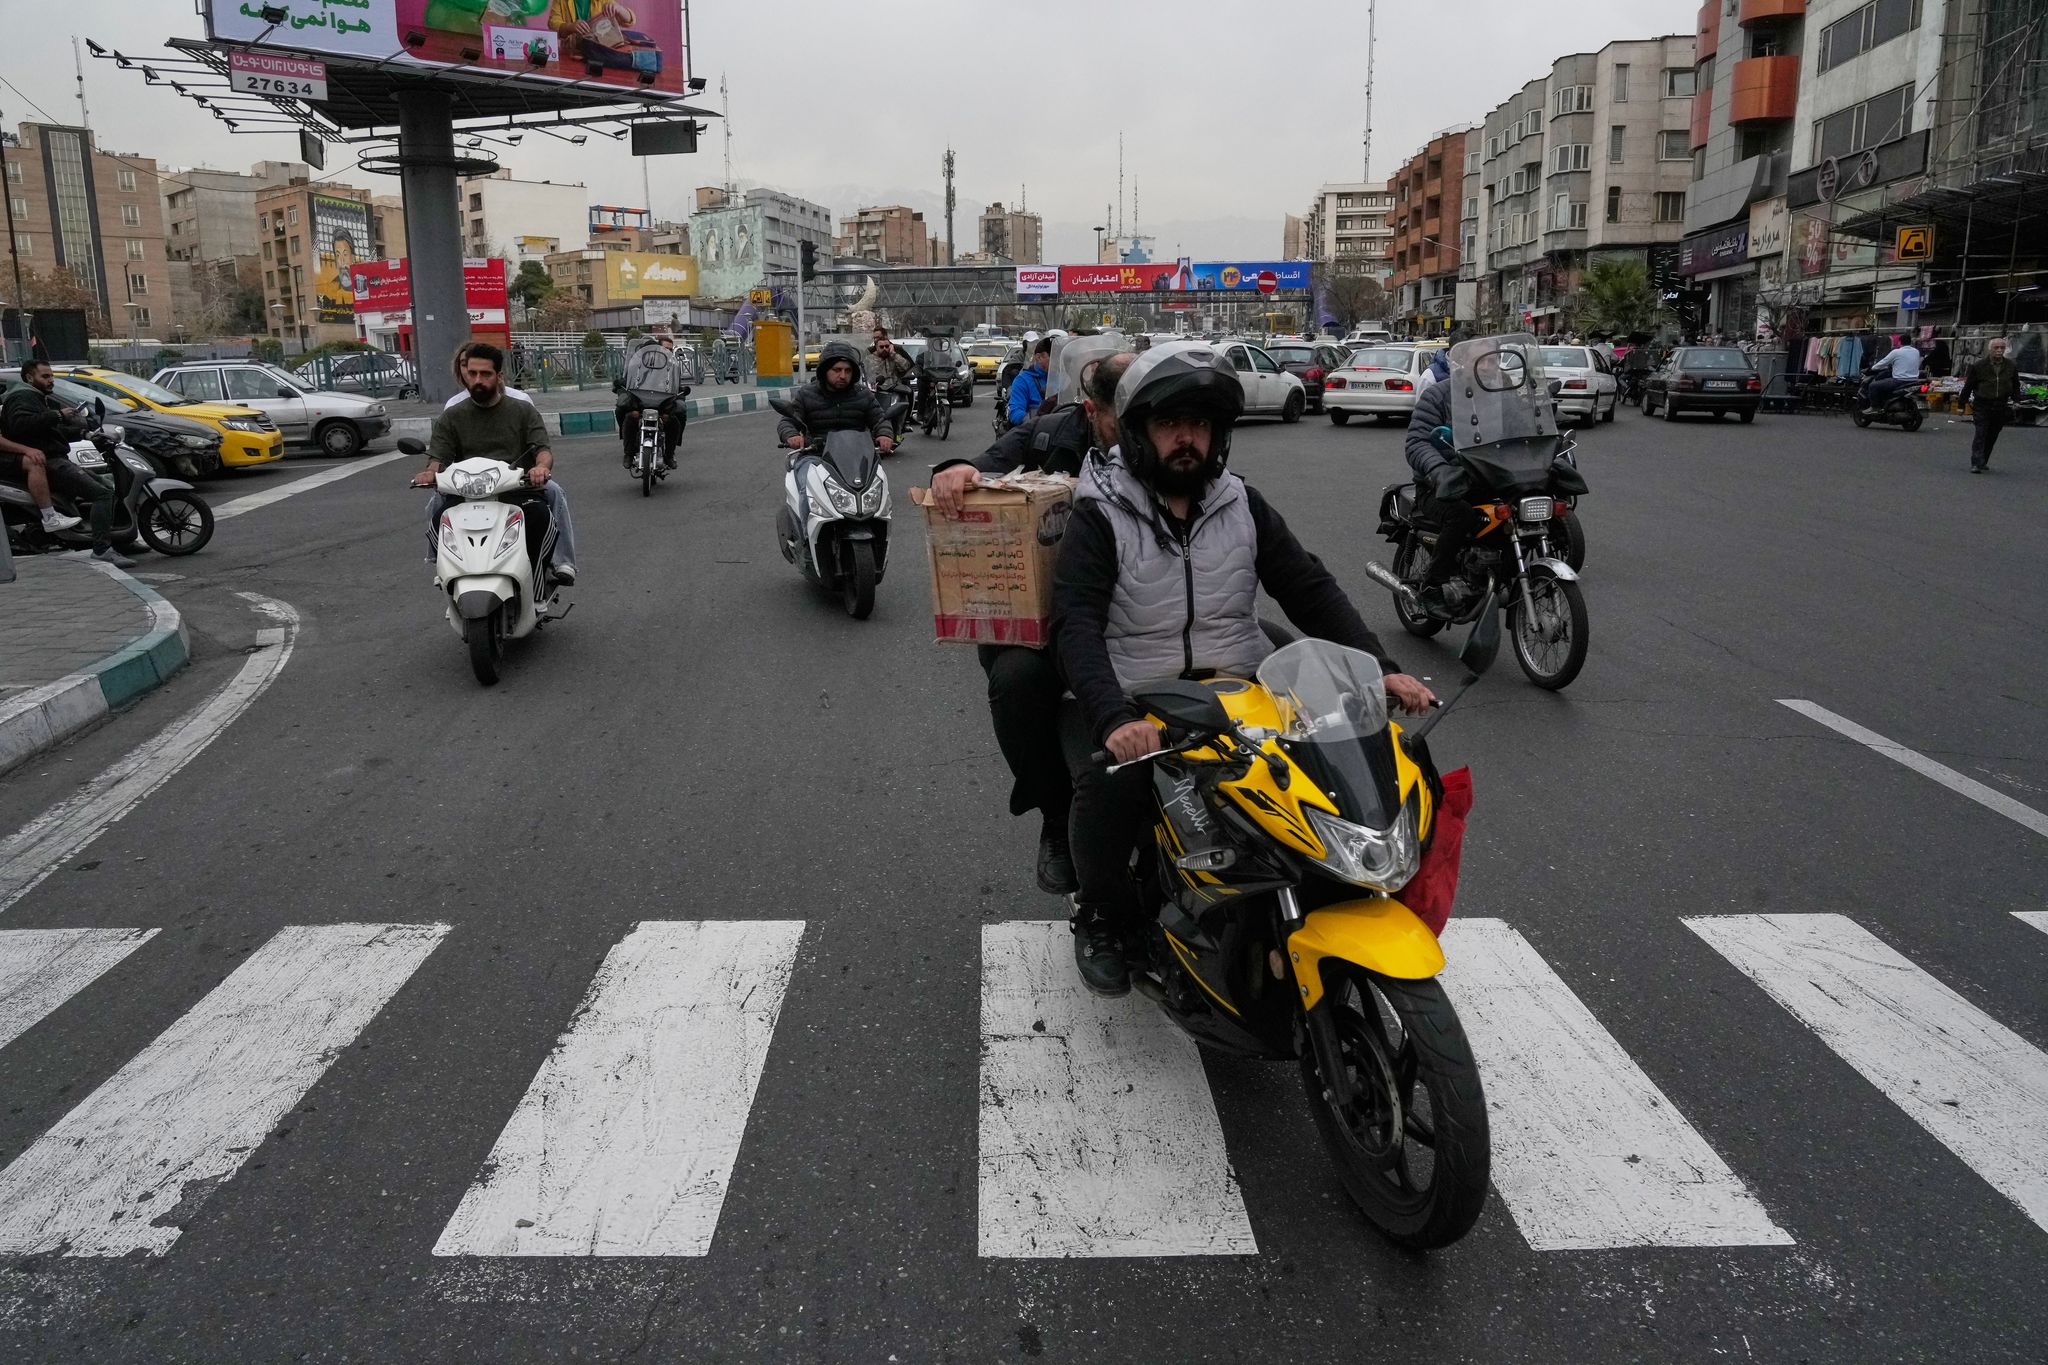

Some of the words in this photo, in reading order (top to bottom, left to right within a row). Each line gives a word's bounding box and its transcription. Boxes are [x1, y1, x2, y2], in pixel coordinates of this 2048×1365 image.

[247, 76, 313, 96] 27634
[1808, 219, 1822, 240] 50
[1021, 272, 1037, 281] آزادی
[1037, 273, 1055, 281] میدان
[1072, 273, 1094, 285] آسان
[1092, 274, 1119, 285] اعتبار
[1120, 268, 1142, 285] ۳۰۰
[1275, 270, 1300, 279] اقساط
